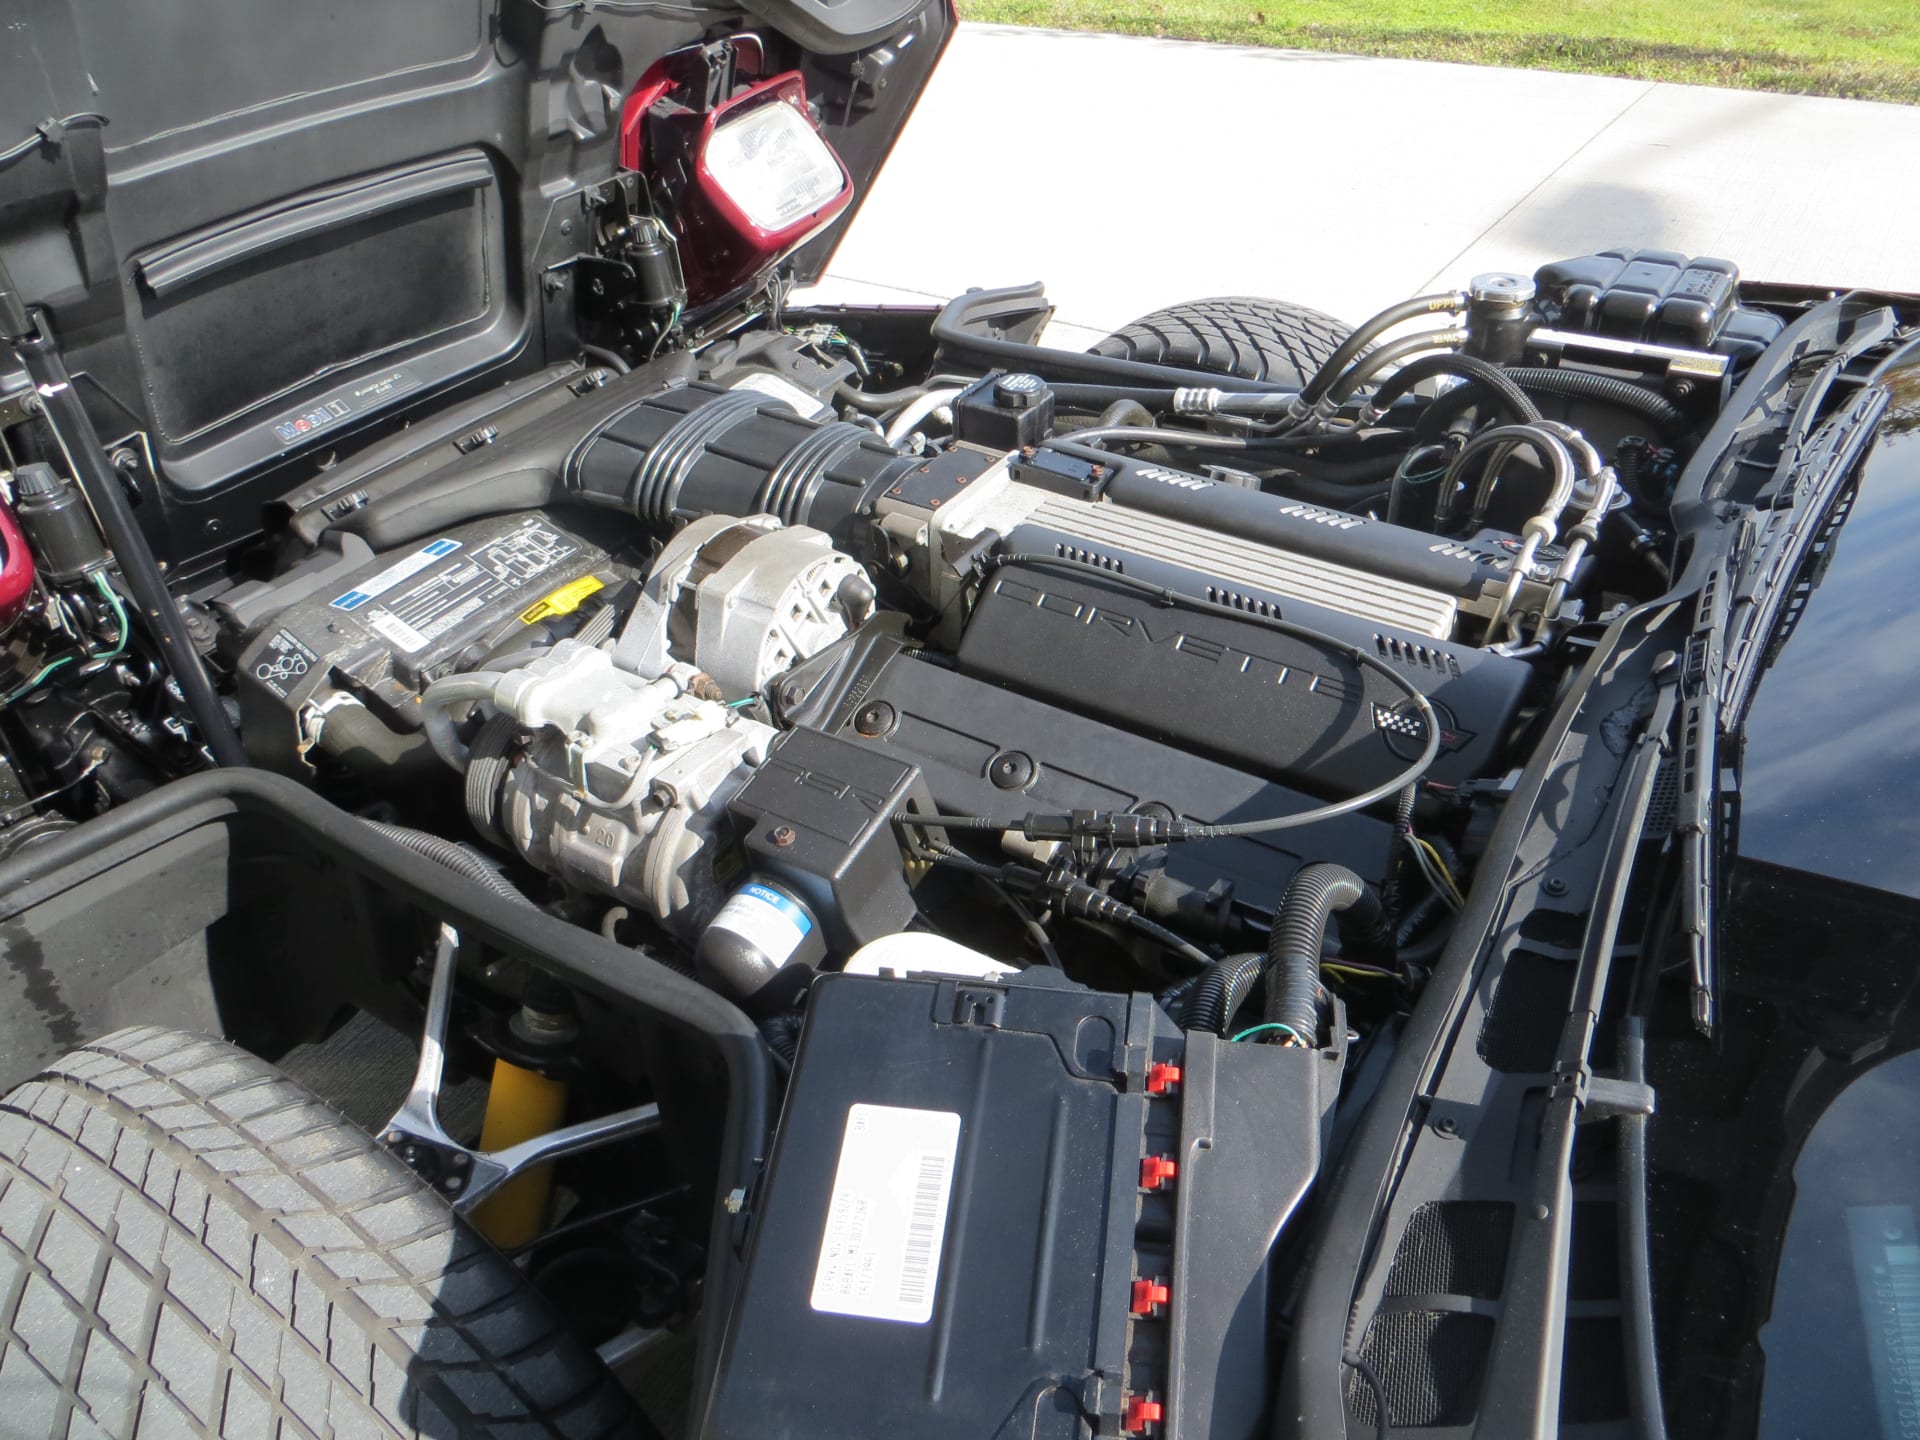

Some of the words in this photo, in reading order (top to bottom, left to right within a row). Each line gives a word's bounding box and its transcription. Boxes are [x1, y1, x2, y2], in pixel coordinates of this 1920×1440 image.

[275, 406, 333, 440] Mobil
[994, 579, 1362, 703] CORVETTE
[595, 828, 615, 848] 20
[748, 886, 781, 904] NOTICE
